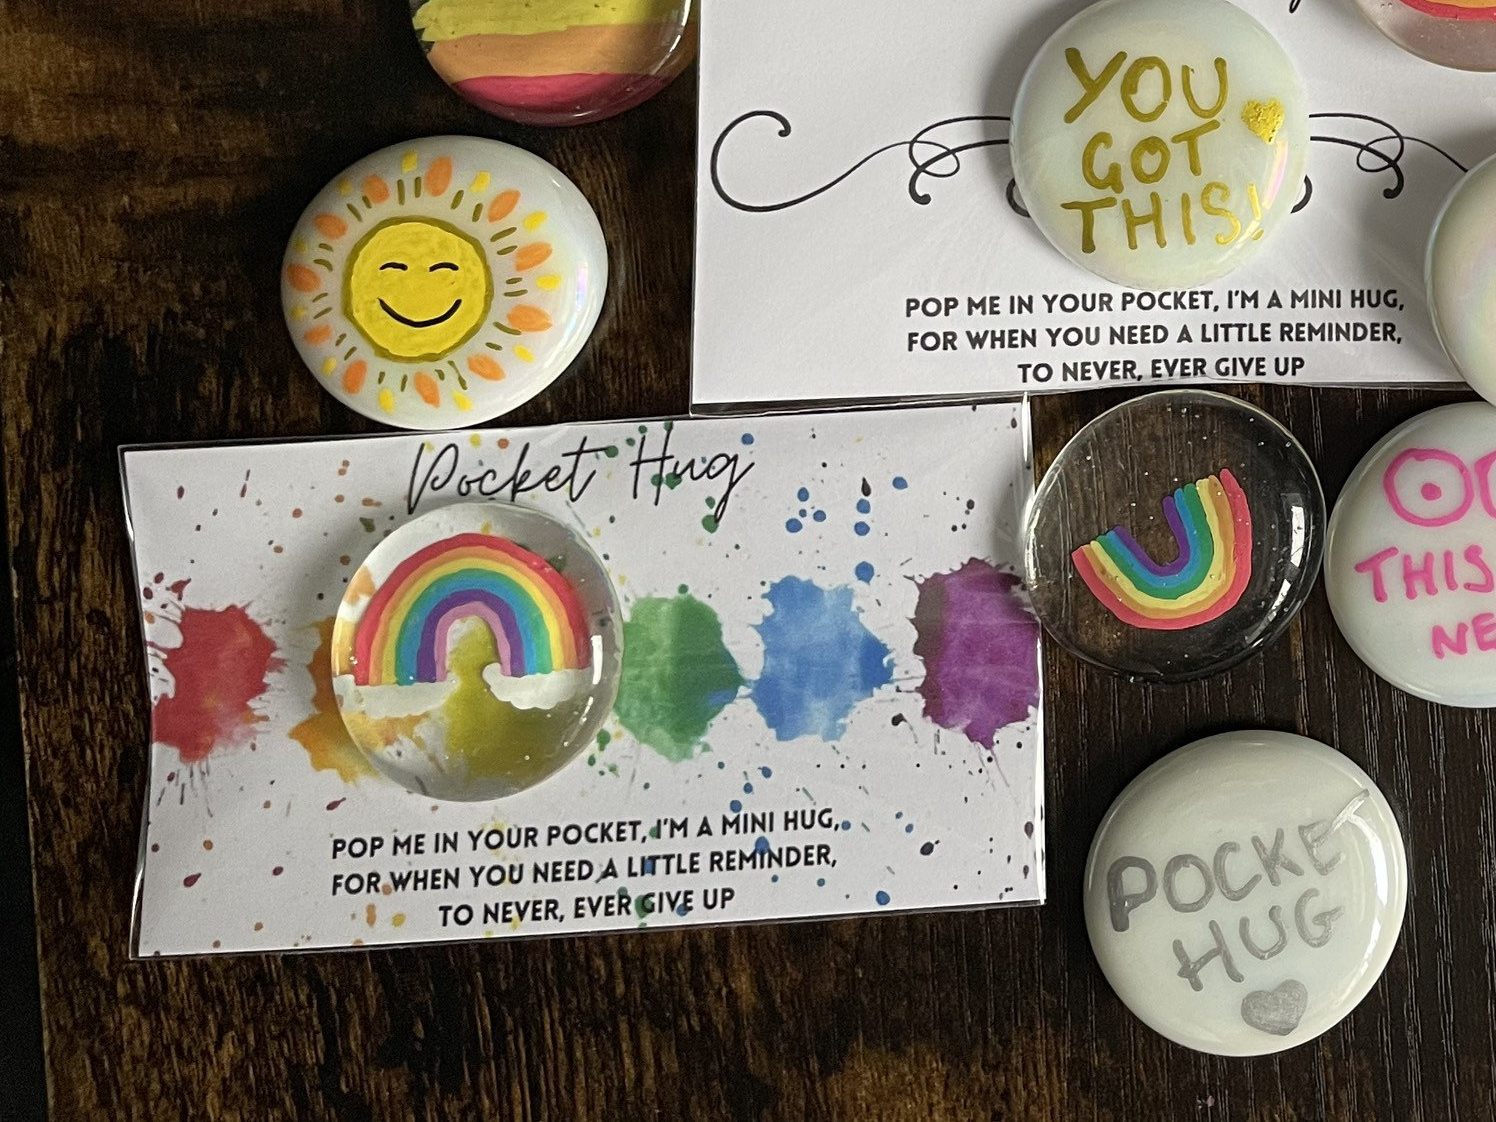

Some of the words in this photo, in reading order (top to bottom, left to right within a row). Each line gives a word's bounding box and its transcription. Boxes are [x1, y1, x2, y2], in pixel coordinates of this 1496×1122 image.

[1063, 47, 1228, 124] YOU
[1081, 118, 1221, 193] GOT
[1061, 181, 1266, 254] THIS!
[905, 296, 958, 317] POP
[967, 295, 1000, 315] ME
[1009, 294, 1033, 314] IN
[1042, 292, 1113, 313] YOUR
[1121, 290, 1219, 312] POCKET,
[1227, 289, 1258, 309] I'M
[1266, 289, 1282, 308] A
[1290, 288, 1341, 308] MINI
[1350, 288, 1404, 311] HUG,
[907, 330, 957, 352] FOR
[965, 328, 1036, 349] WHEN
[1045, 326, 1100, 347] YOU
[1109, 324, 1168, 345] NEED
[1176, 324, 1193, 343] A
[1200, 322, 1271, 342] LITTLE
[1279, 321, 1401, 344] REMINDER,
[1017, 362, 1053, 383] TO
[1062, 359, 1142, 381] NEVER,
[1151, 357, 1207, 378] EVER
[1214, 356, 1266, 376] GIVE
[1274, 356, 1304, 376] UP
[407, 435, 609, 516] Pocket
[629, 420, 755, 523] Hug
[1354, 545, 1496, 604] THIS
[332, 836, 384, 859] POP
[392, 833, 425, 856] ME
[434, 831, 458, 853] IN
[467, 826, 538, 850] YOUR
[546, 819, 646, 846] POCKET,
[654, 816, 688, 839] I'M
[696, 815, 712, 837] A
[721, 811, 774, 835] MINI
[783, 807, 839, 831] HUG,
[1173, 888, 1346, 992] HUG
